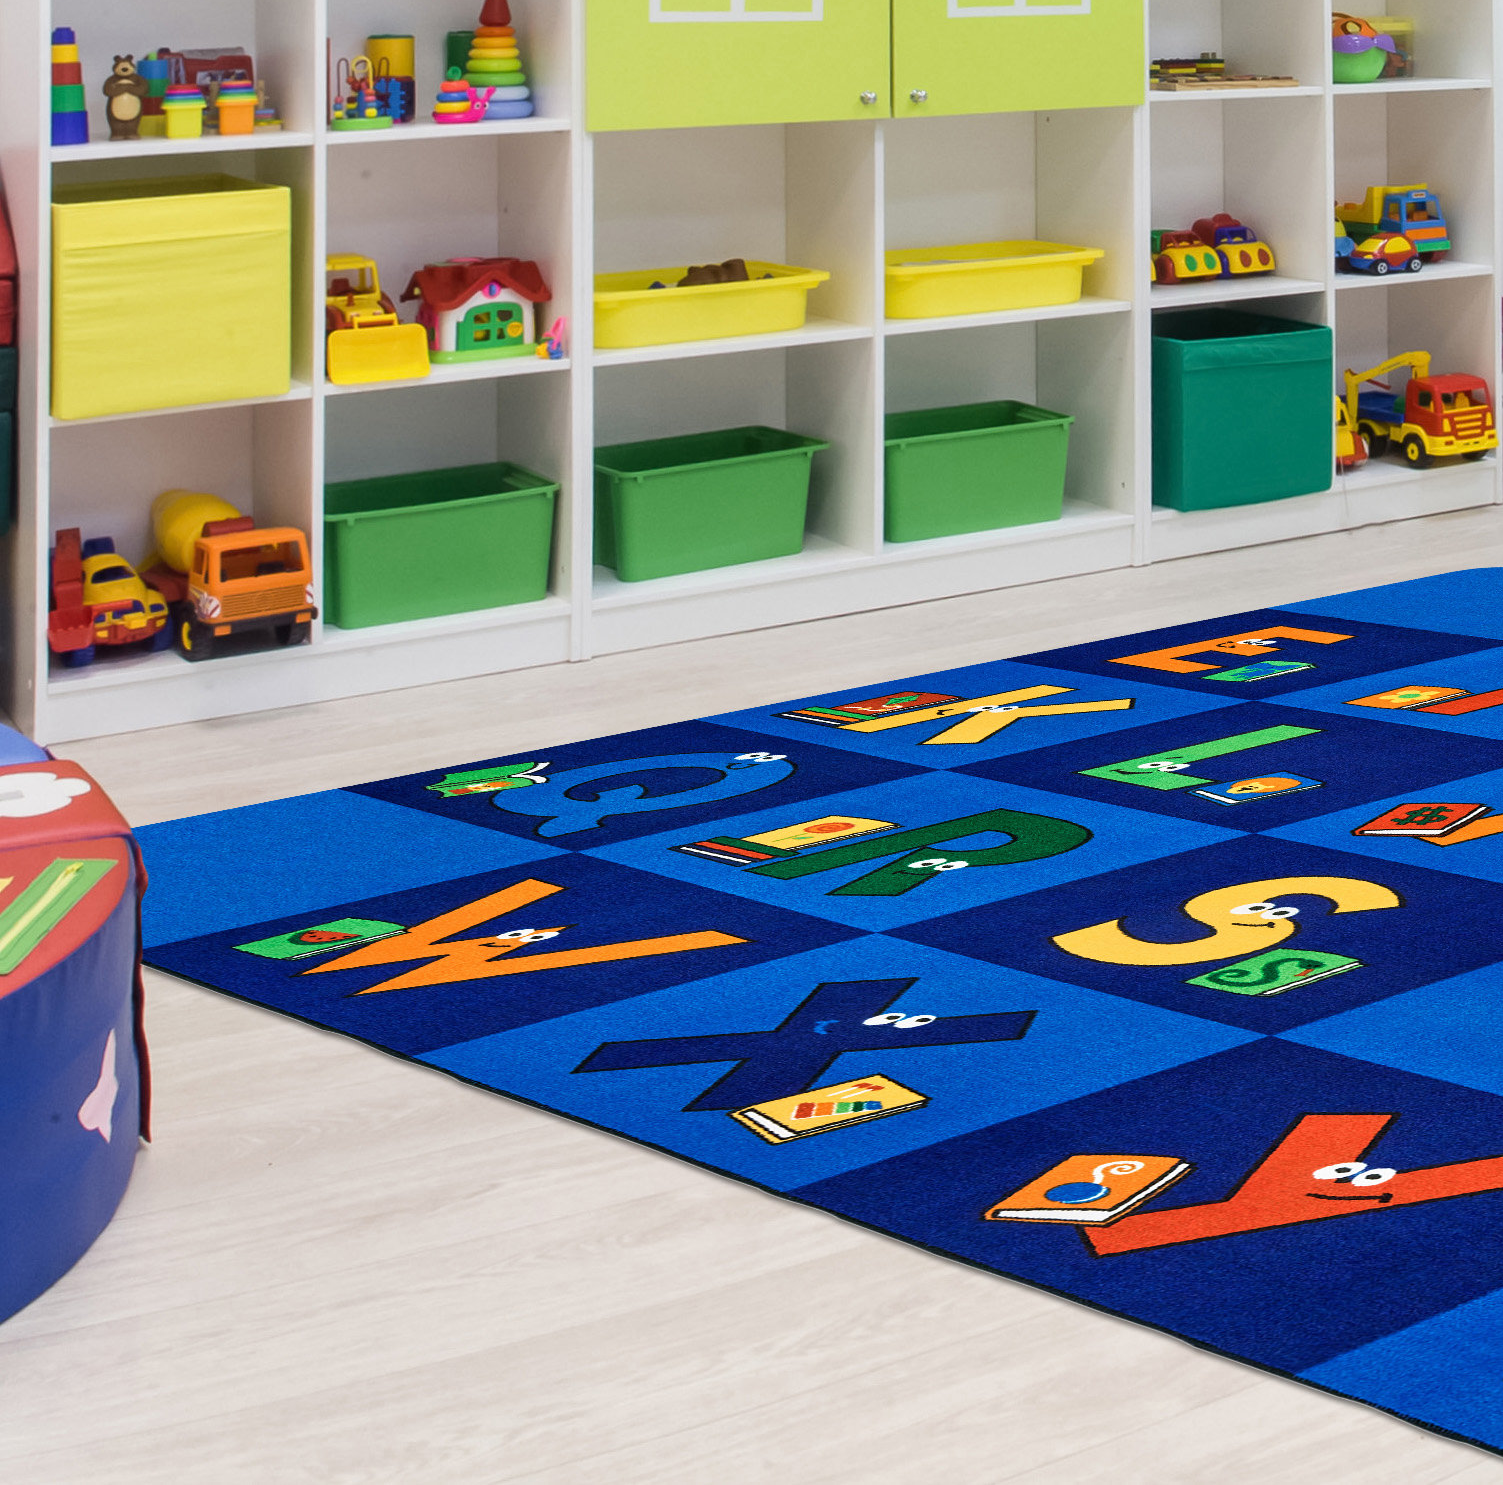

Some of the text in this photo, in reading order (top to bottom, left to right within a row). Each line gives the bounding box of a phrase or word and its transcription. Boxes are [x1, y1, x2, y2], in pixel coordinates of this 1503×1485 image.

[1105, 625, 1356, 674] E
[836, 684, 1136, 745] K
[1077, 723, 1327, 791] L
[490, 751, 798, 838] Q
[742, 807, 1093, 896] R
[288, 876, 757, 998] W
[1050, 875, 1406, 967] S
[570, 977, 1038, 1113] X
